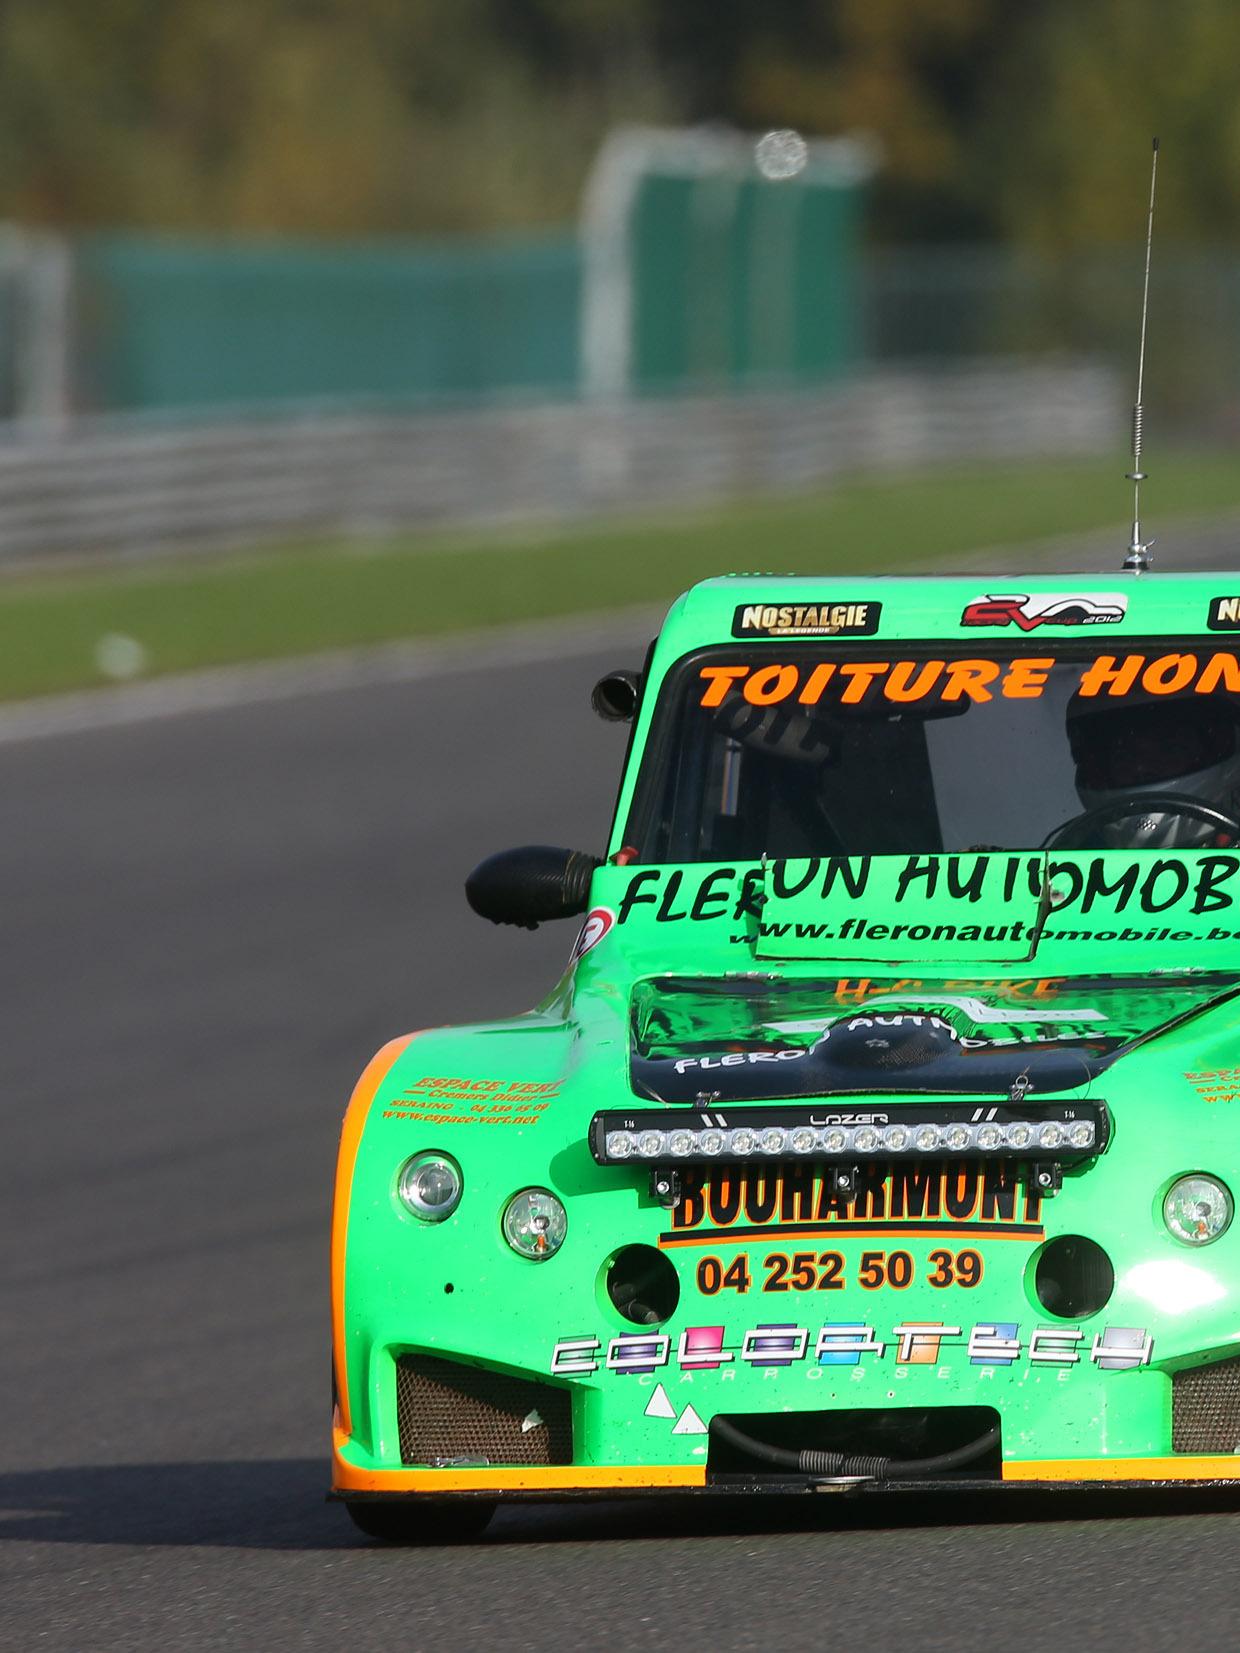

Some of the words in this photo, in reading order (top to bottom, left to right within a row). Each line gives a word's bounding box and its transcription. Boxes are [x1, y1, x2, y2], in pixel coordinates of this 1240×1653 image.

[741, 603, 868, 629] NOSTALGIE
[699, 657, 1055, 706] TOITURE
[696, 1252, 753, 1296] 04
[762, 1250, 846, 1293] 252
[858, 1249, 914, 1291] 50
[926, 1247, 985, 1289] 39
